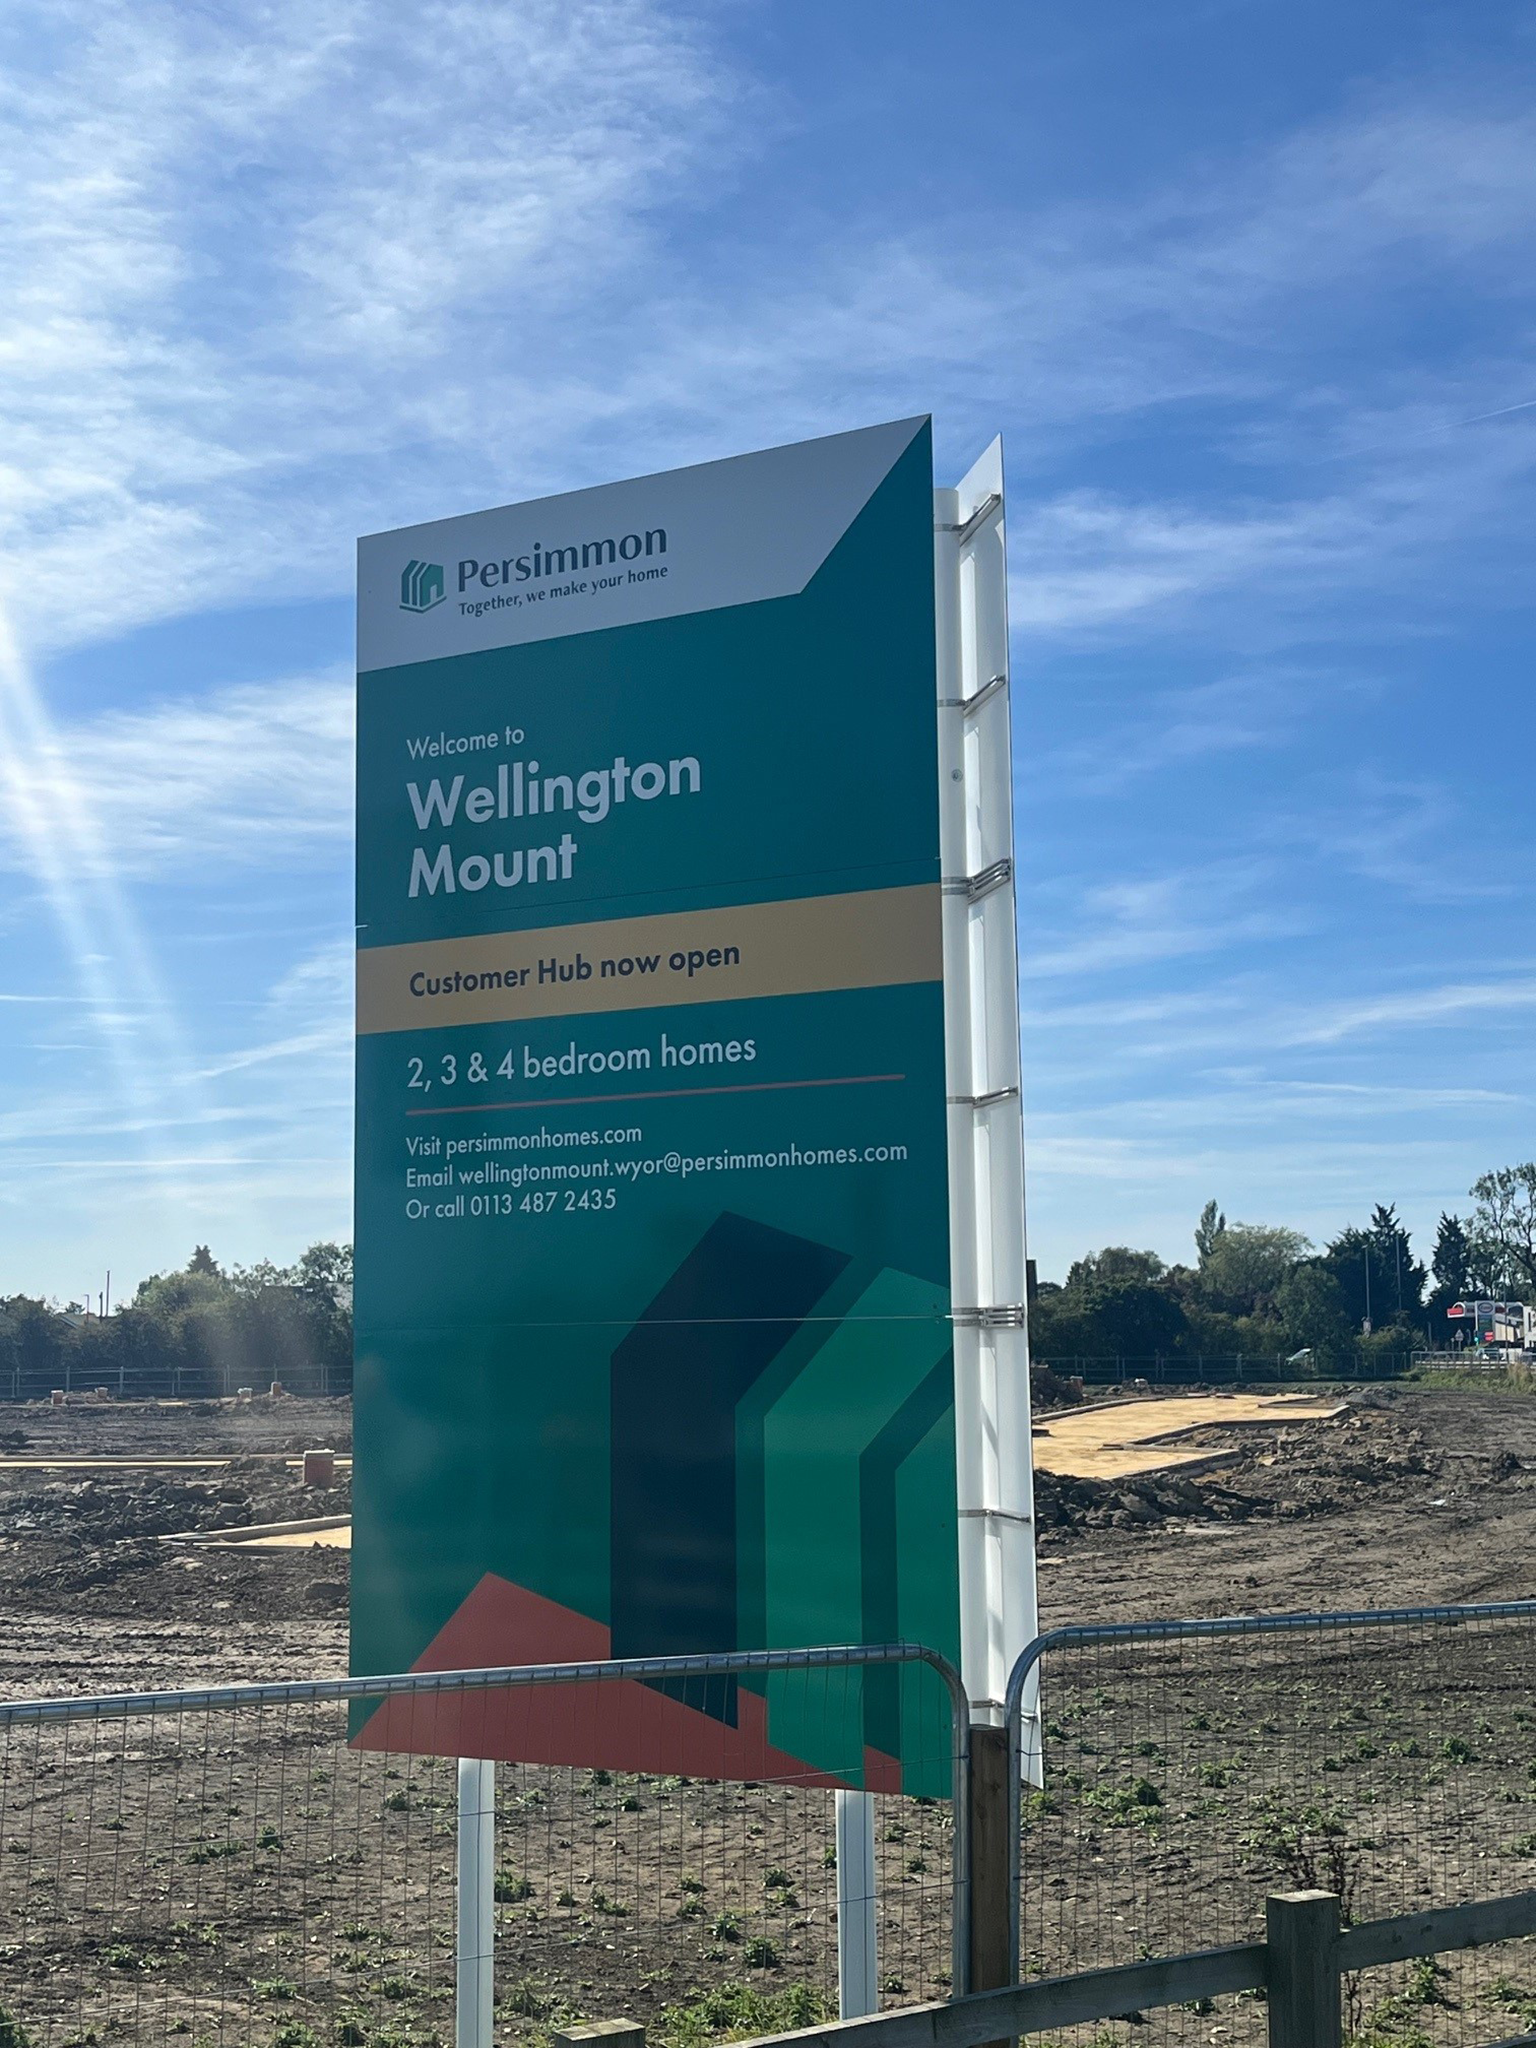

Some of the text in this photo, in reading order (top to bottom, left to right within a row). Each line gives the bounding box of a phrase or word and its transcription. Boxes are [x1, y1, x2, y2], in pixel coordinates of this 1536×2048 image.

[458, 528, 667, 592] Persimmon
[459, 566, 668, 617] Together, we make your home
[406, 726, 525, 760] Welcome to
[406, 757, 701, 831] Wellington
[408, 834, 578, 898] Mount
[409, 947, 740, 997] Customer Hub now open
[407, 1033, 757, 1093] 2, 3 & 4 bedroom homes
[406, 1126, 642, 1160] Visit persimmonhomes.com
[406, 1143, 908, 1188] Email wellingtonmount.wyor@persimmonhomes.com
[406, 1188, 617, 1219] Or call 0113 487 2435
